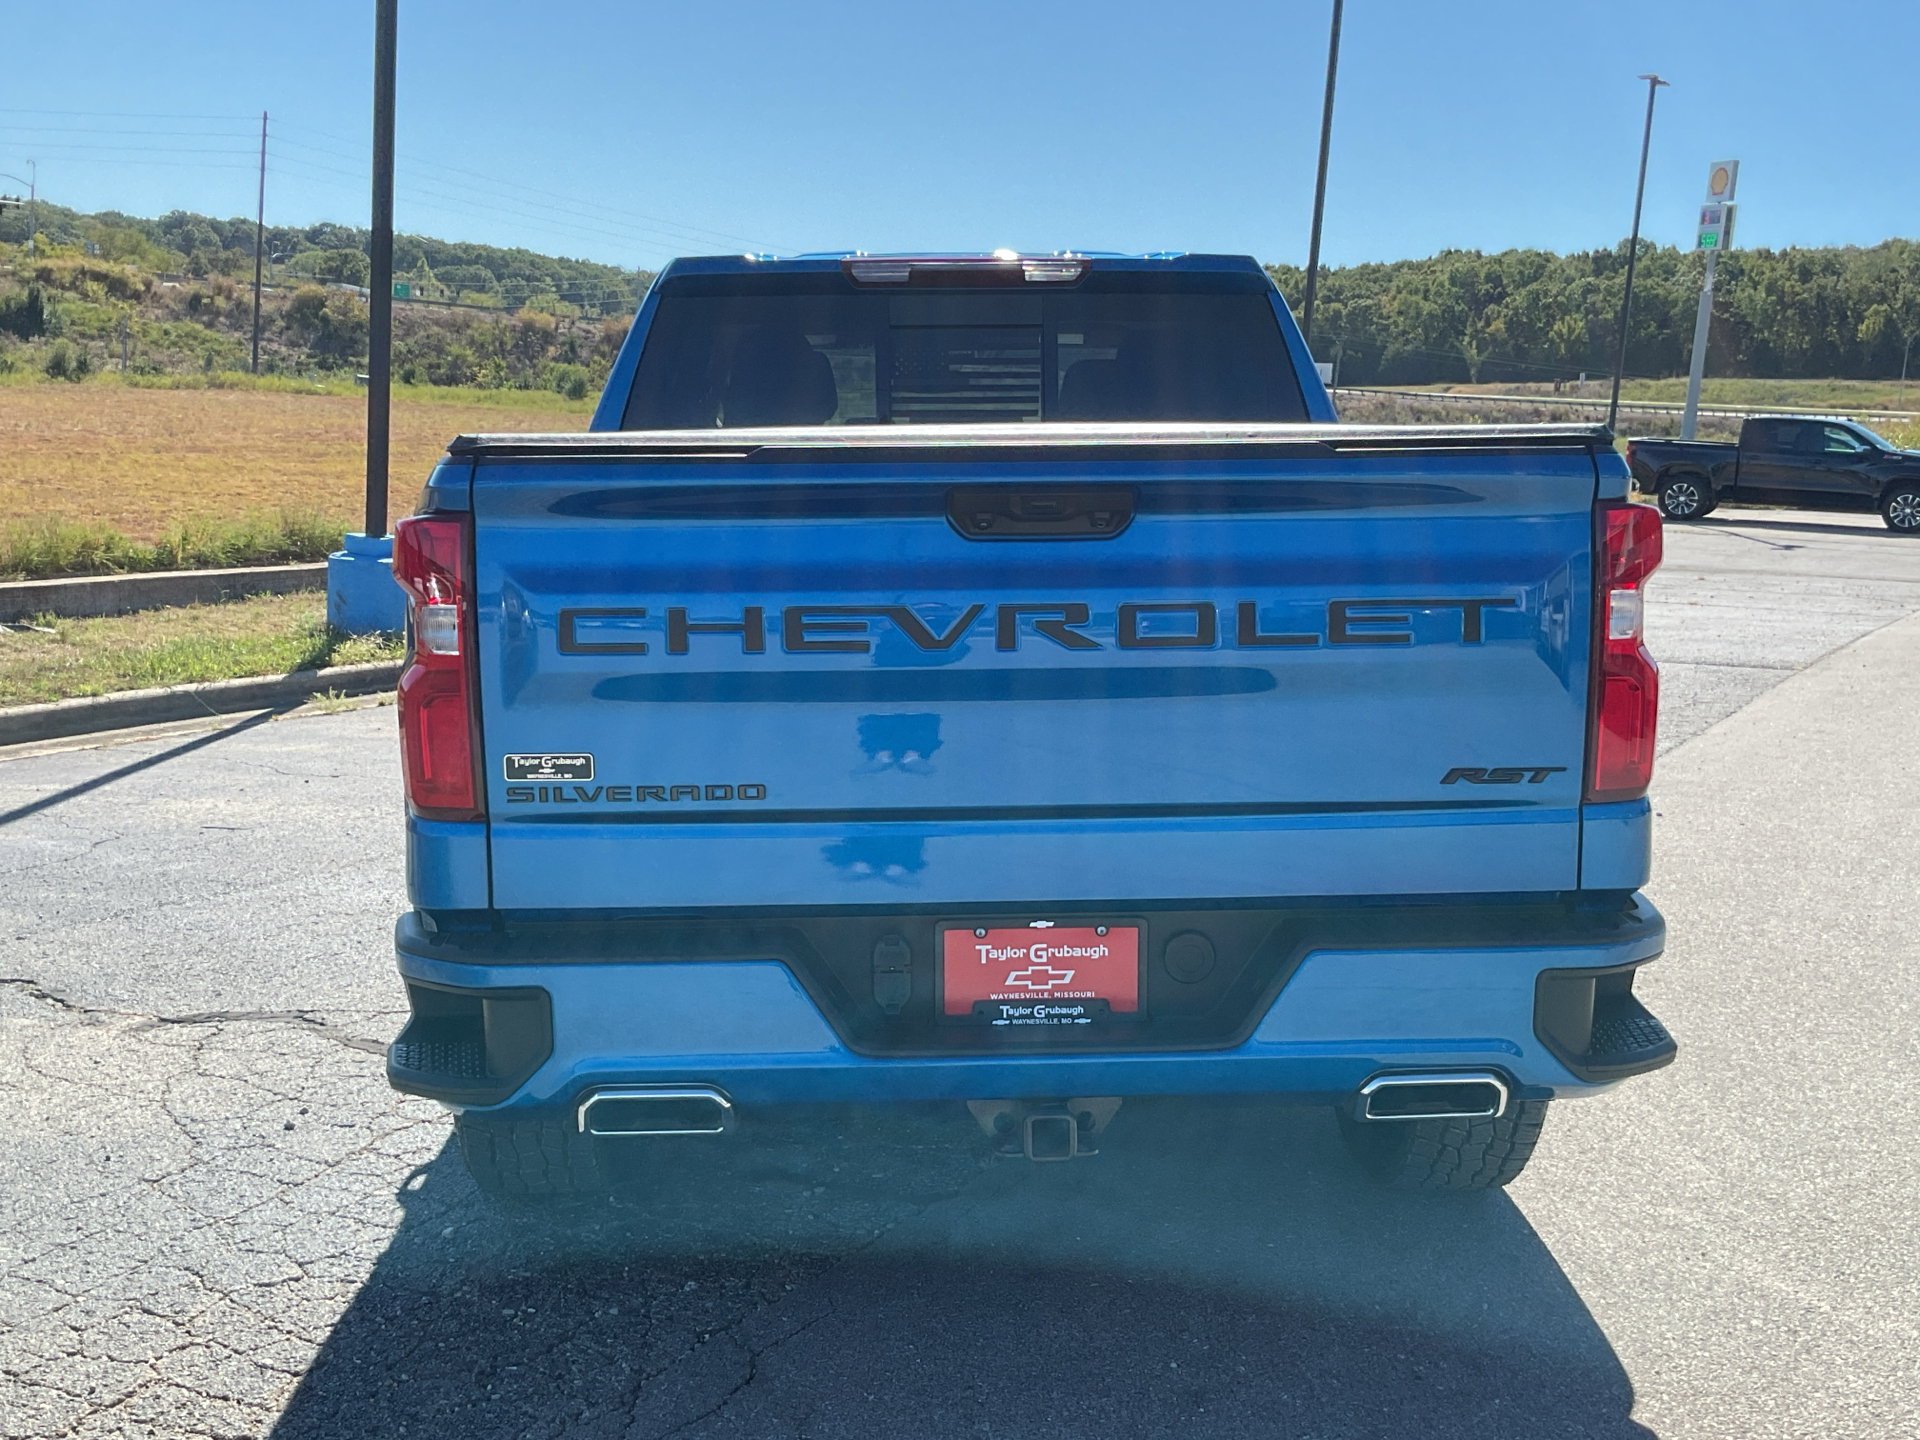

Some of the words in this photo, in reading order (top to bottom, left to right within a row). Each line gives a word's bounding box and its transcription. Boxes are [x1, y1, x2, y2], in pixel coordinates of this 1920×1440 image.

[557, 598, 1520, 654] CHEVROLET
[511, 756, 541, 768] Taylor
[541, 756, 586, 768] Grubaugh
[1439, 767, 1567, 784] RST
[506, 784, 767, 803] SILVERADO
[975, 944, 1026, 964] Taylor
[1029, 943, 1108, 963] Grubaugh
[990, 992, 1051, 1000] WAYNESVILLE,
[1054, 991, 1095, 999] MISSOURI
[1000, 1005, 1032, 1018] Taylor
[1033, 1005, 1084, 1018] Grubaugh
